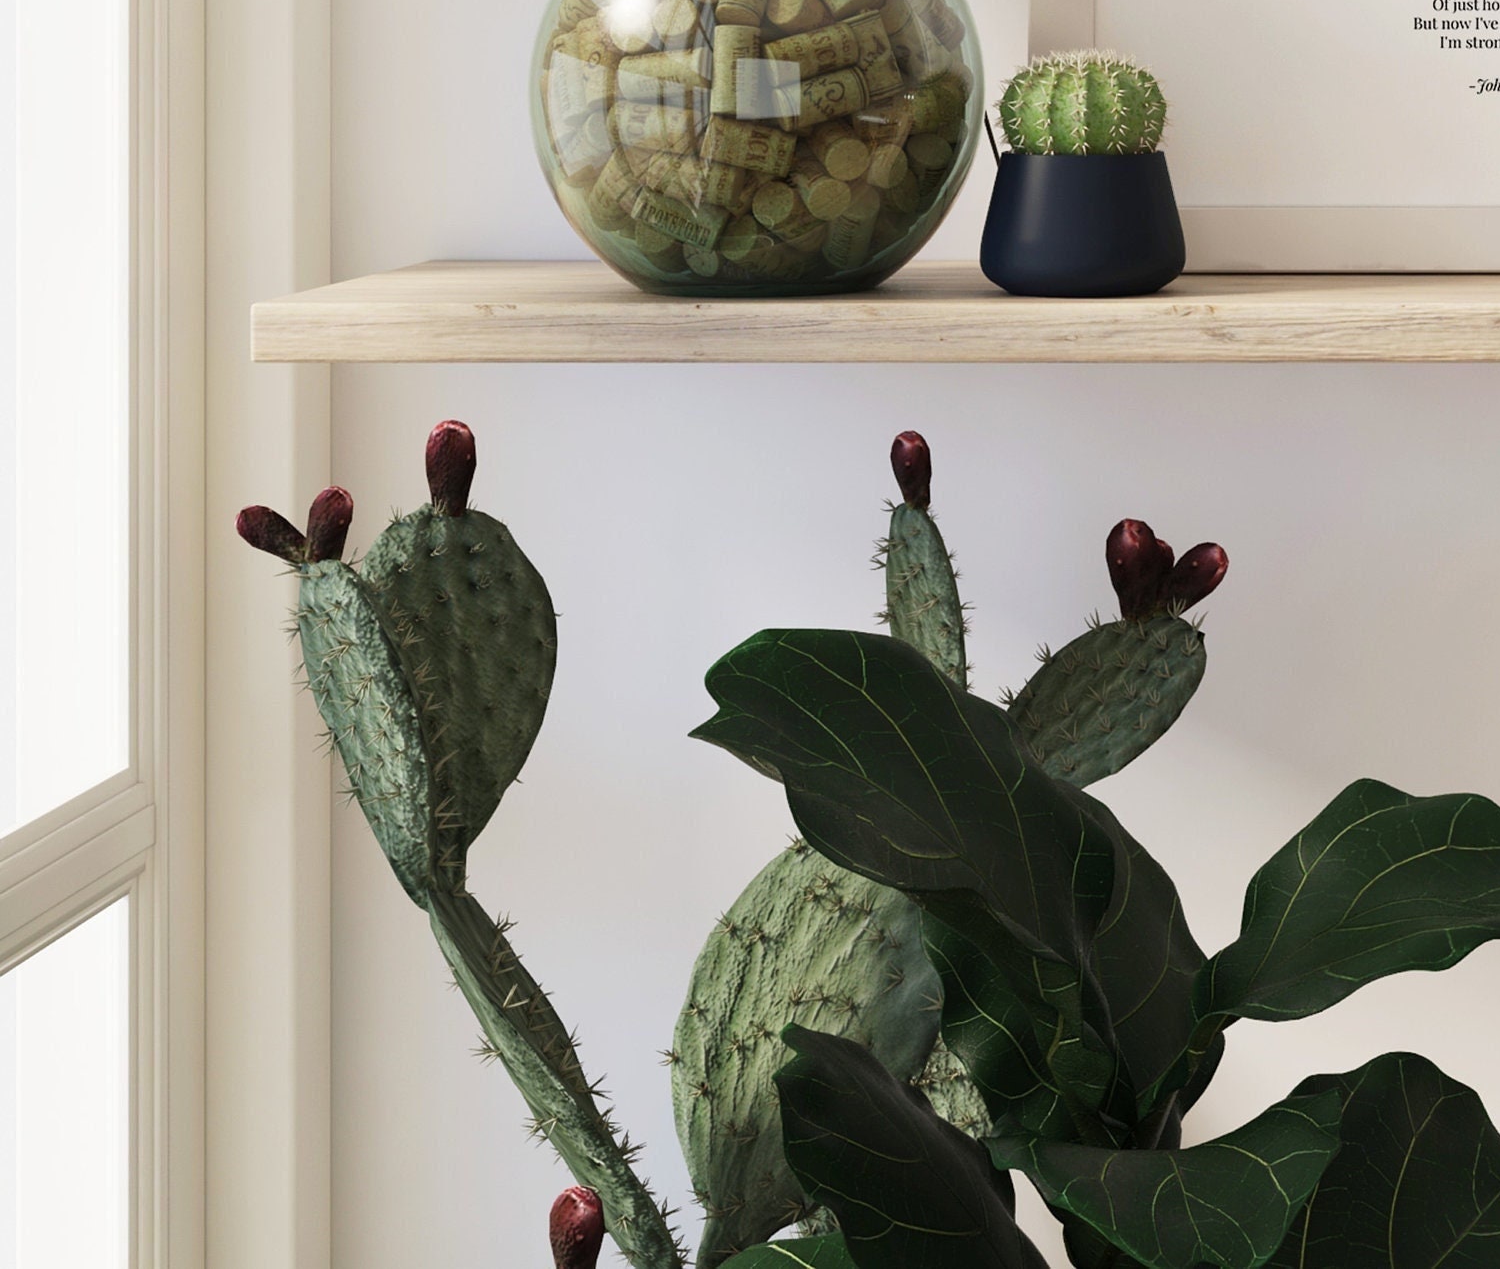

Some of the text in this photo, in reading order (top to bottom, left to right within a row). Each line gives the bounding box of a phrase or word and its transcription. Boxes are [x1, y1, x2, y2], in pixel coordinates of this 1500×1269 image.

[1413, 17, 1438, 31] But
[1441, 19, 1472, 31] now
[1475, 16, 1499, 31] I've
[1440, 35, 1462, 49] I'm
